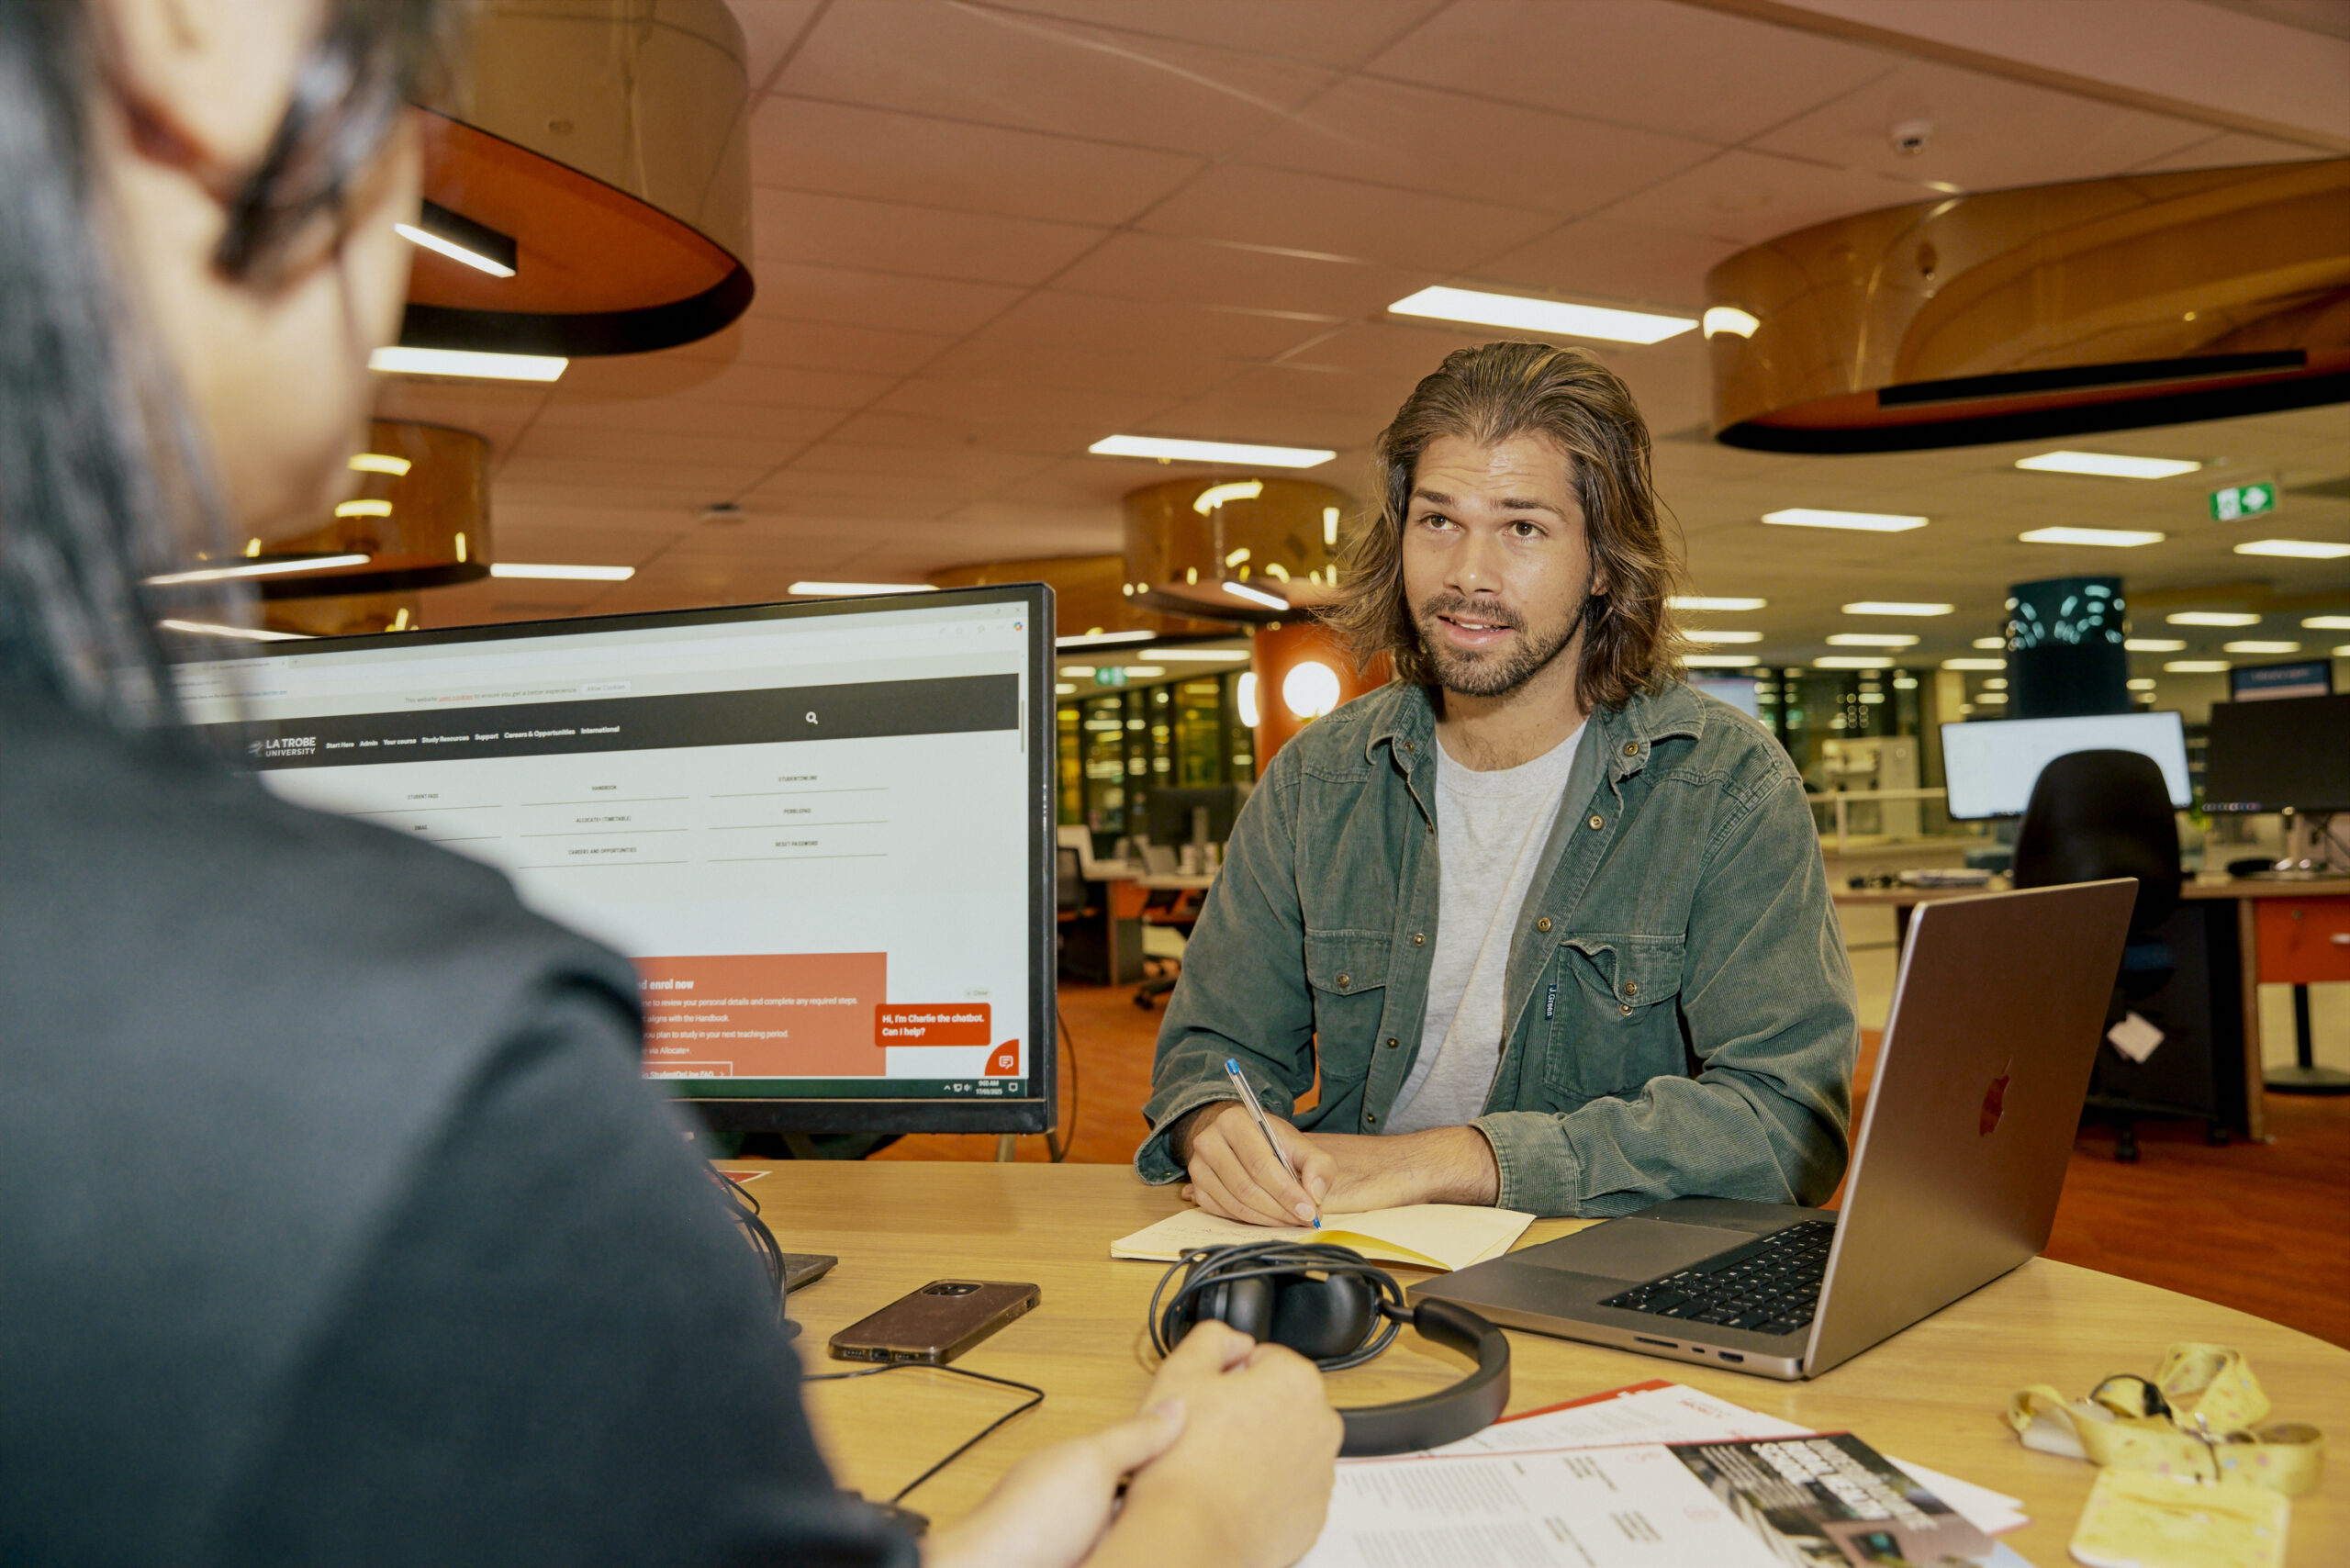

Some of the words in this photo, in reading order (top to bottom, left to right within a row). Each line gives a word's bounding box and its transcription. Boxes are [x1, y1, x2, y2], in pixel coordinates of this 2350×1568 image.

[534, 729, 576, 738] Opportunities
[581, 726, 620, 734] International
[266, 739, 280, 749] LA
[281, 736, 317, 748] TROBE
[265, 747, 316, 757] UNIVERSITY
[649, 978, 673, 990] enrol
[675, 980, 694, 990] now
[683, 999, 696, 1008] your
[698, 998, 727, 1008] personal
[727, 997, 750, 1006] details
[764, 997, 795, 1006] complete
[809, 997, 837, 1006] required
[838, 997, 857, 1006] steps.
[1546, 987, 1556, 1016] J.Green
[648, 1015, 667, 1024] aligns
[695, 1014, 729, 1022] Handbook.
[882, 1014, 894, 1024] Hi,
[895, 1014, 907, 1023] I'm
[908, 1014, 936, 1023] Charlie
[937, 1014, 951, 1022] the
[951, 1014, 985, 1022] chatbot.
[656, 1031, 671, 1040] plan
[680, 1030, 698, 1040] study
[706, 1031, 720, 1040] your
[737, 1030, 766, 1039] teaching
[767, 1030, 788, 1039] period.
[882, 1028, 898, 1036] Can
[904, 1027, 926, 1037] help?
